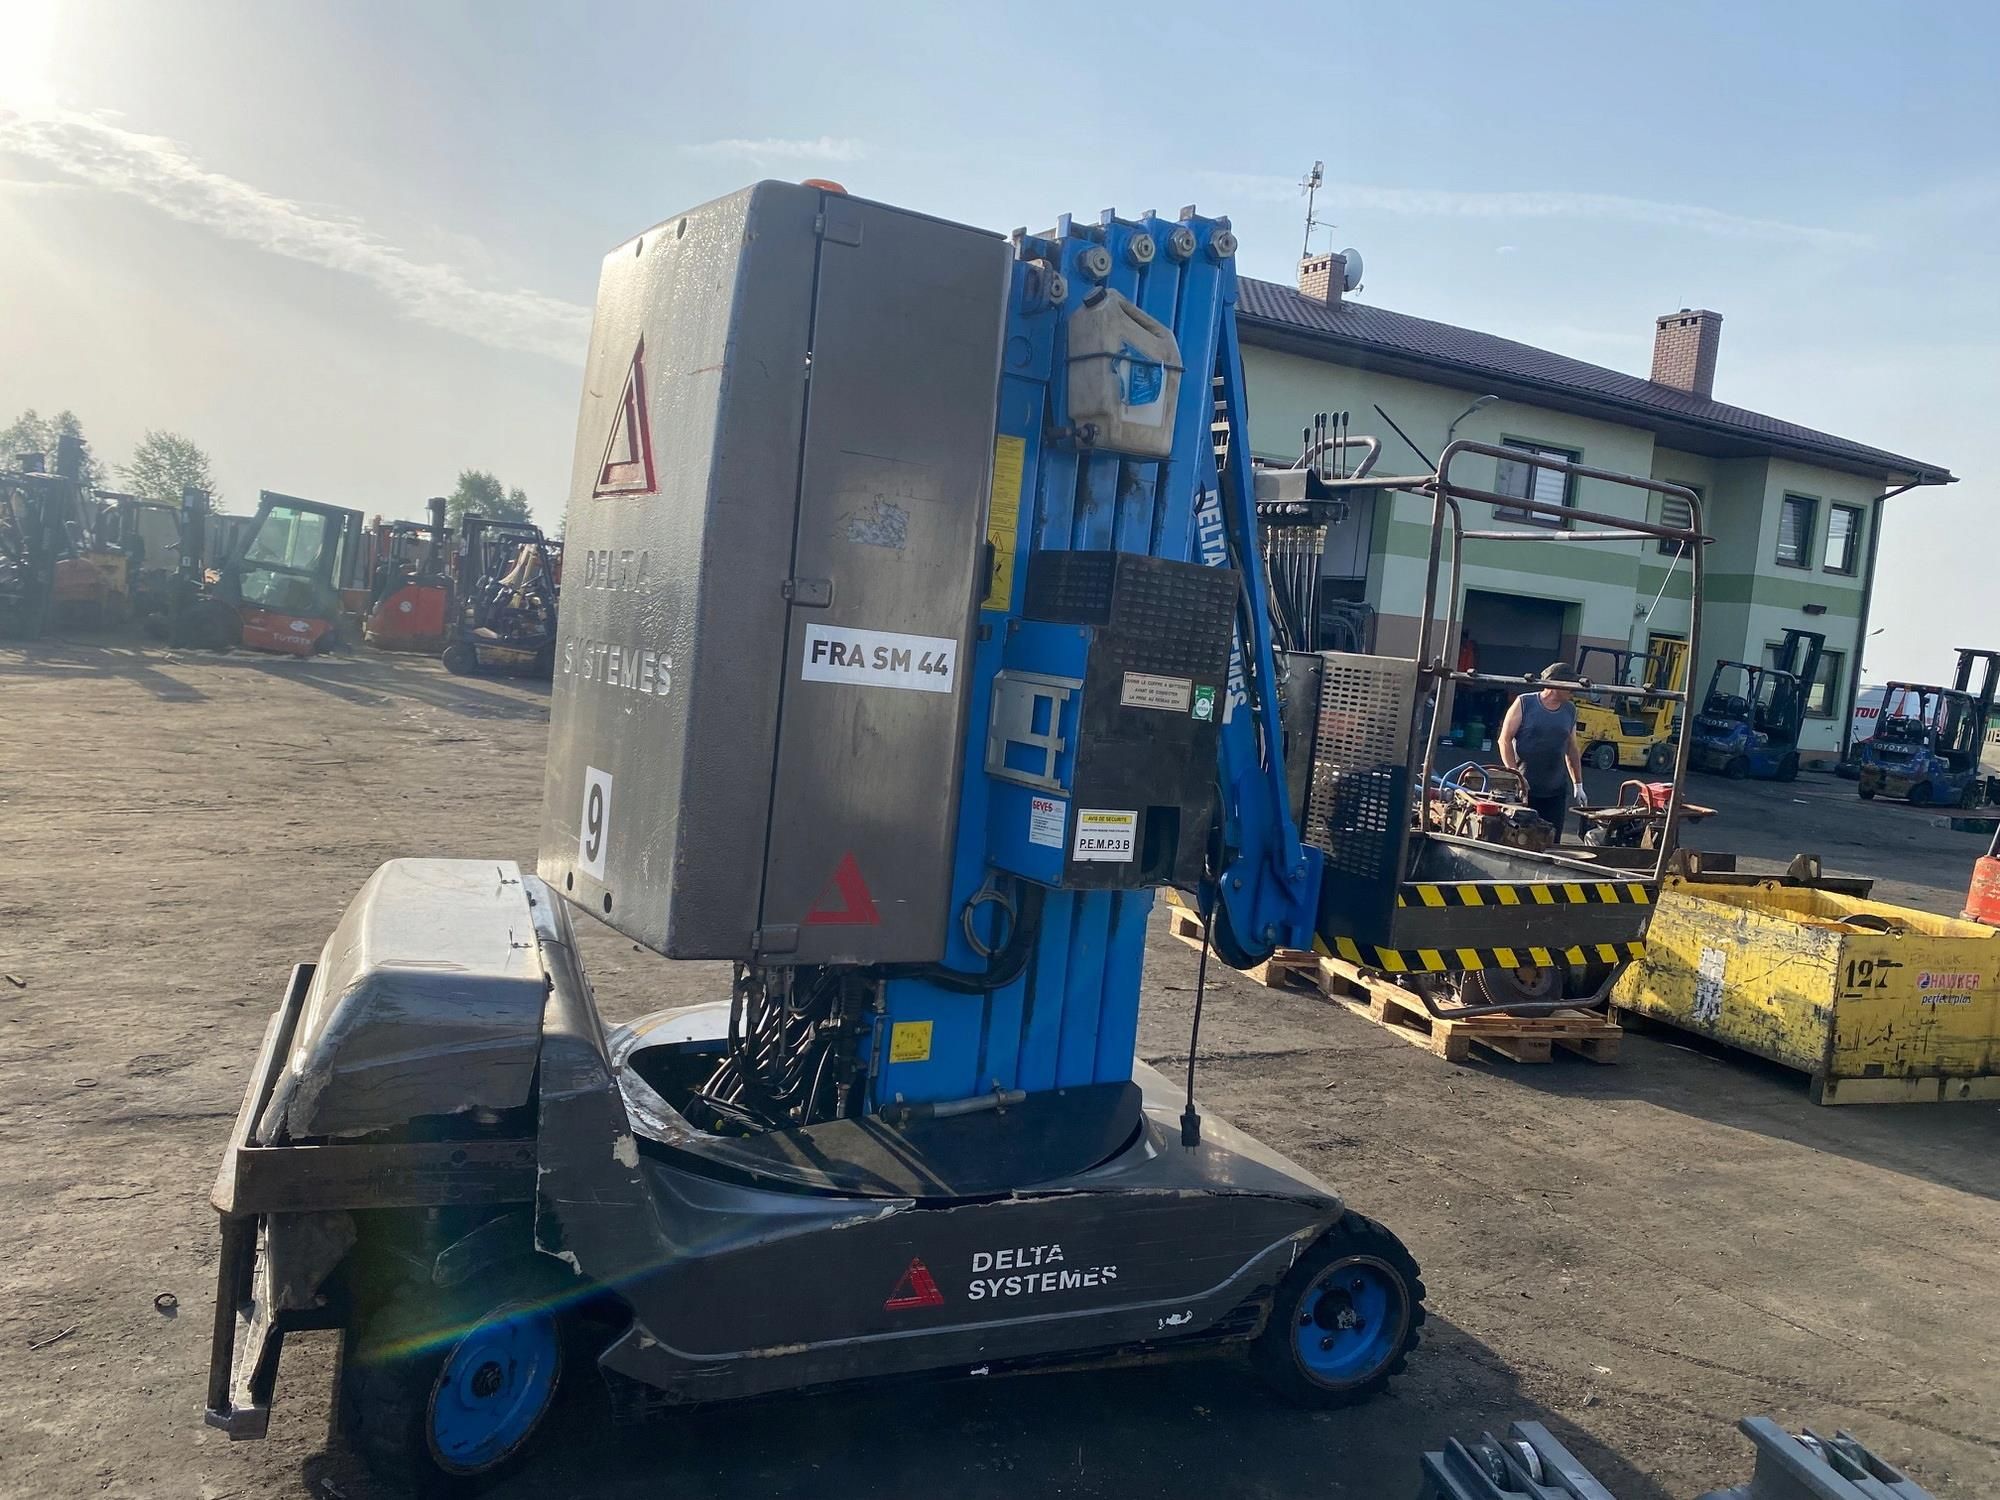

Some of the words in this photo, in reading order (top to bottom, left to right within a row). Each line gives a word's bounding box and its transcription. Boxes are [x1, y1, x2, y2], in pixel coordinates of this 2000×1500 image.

[1196, 489, 1227, 567] DELTA
[584, 550, 651, 594] DELTA
[564, 635, 673, 696] SYSTEMES
[811, 639, 865, 668] FRA
[872, 646, 911, 672] SM
[917, 651, 948, 676] 44
[1873, 742, 1909, 753] TOYOTA
[585, 783, 603, 862] 9
[1123, 840, 1130, 850] B
[1930, 973, 1981, 989] HAWKER
[972, 1244, 1064, 1273] DELTA
[967, 1265, 1118, 1301] SYSTEMES
